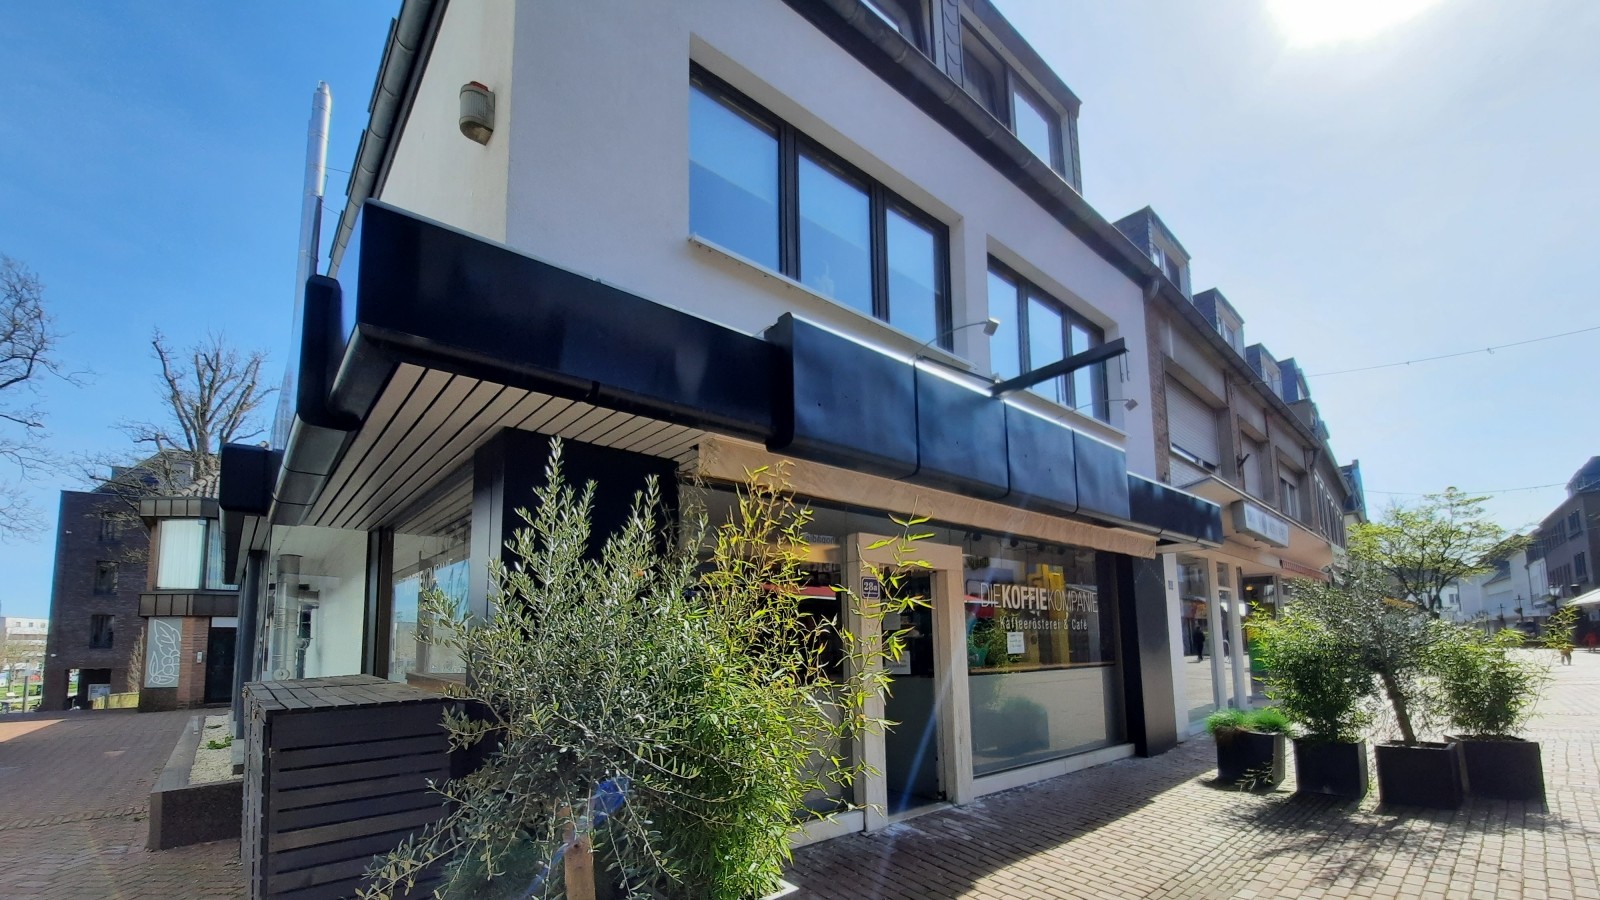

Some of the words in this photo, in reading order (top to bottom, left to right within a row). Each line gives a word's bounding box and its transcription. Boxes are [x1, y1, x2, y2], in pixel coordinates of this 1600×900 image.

[864, 582, 878, 591] 28a
[1000, 616, 1060, 630] Kaffeerösterei
[1064, 619, 1068, 629] &
